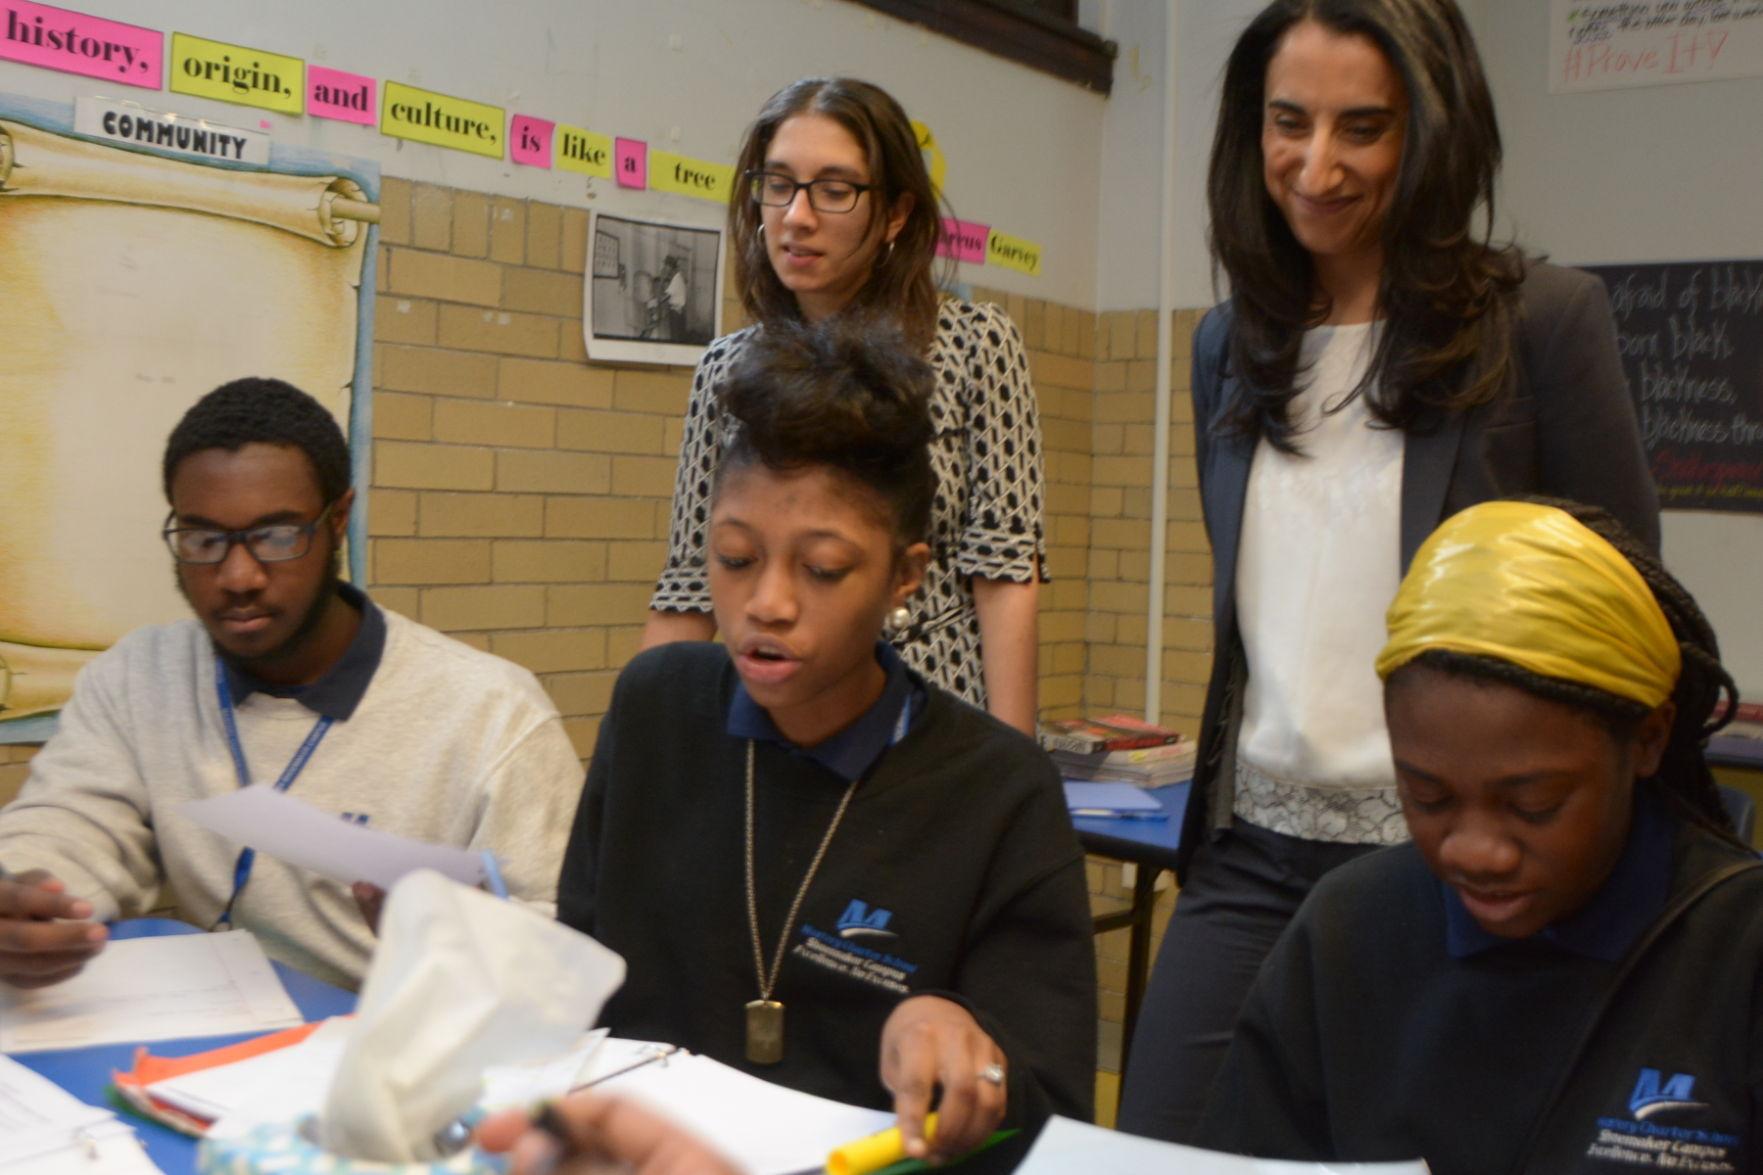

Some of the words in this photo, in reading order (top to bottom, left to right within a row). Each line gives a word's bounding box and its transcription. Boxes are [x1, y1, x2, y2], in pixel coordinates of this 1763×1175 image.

[6, 9, 149, 74] history,
[183, 55, 292, 98] origin,
[313, 84, 369, 112] and
[390, 101, 497, 145] culture,
[521, 126, 541, 153] is
[562, 133, 606, 166] like
[624, 155, 636, 174] a
[673, 162, 716, 191] tree
[103, 111, 248, 160] COMMUNITY
[991, 235, 1039, 272] Garvey
[1678, 268, 1702, 318] of
